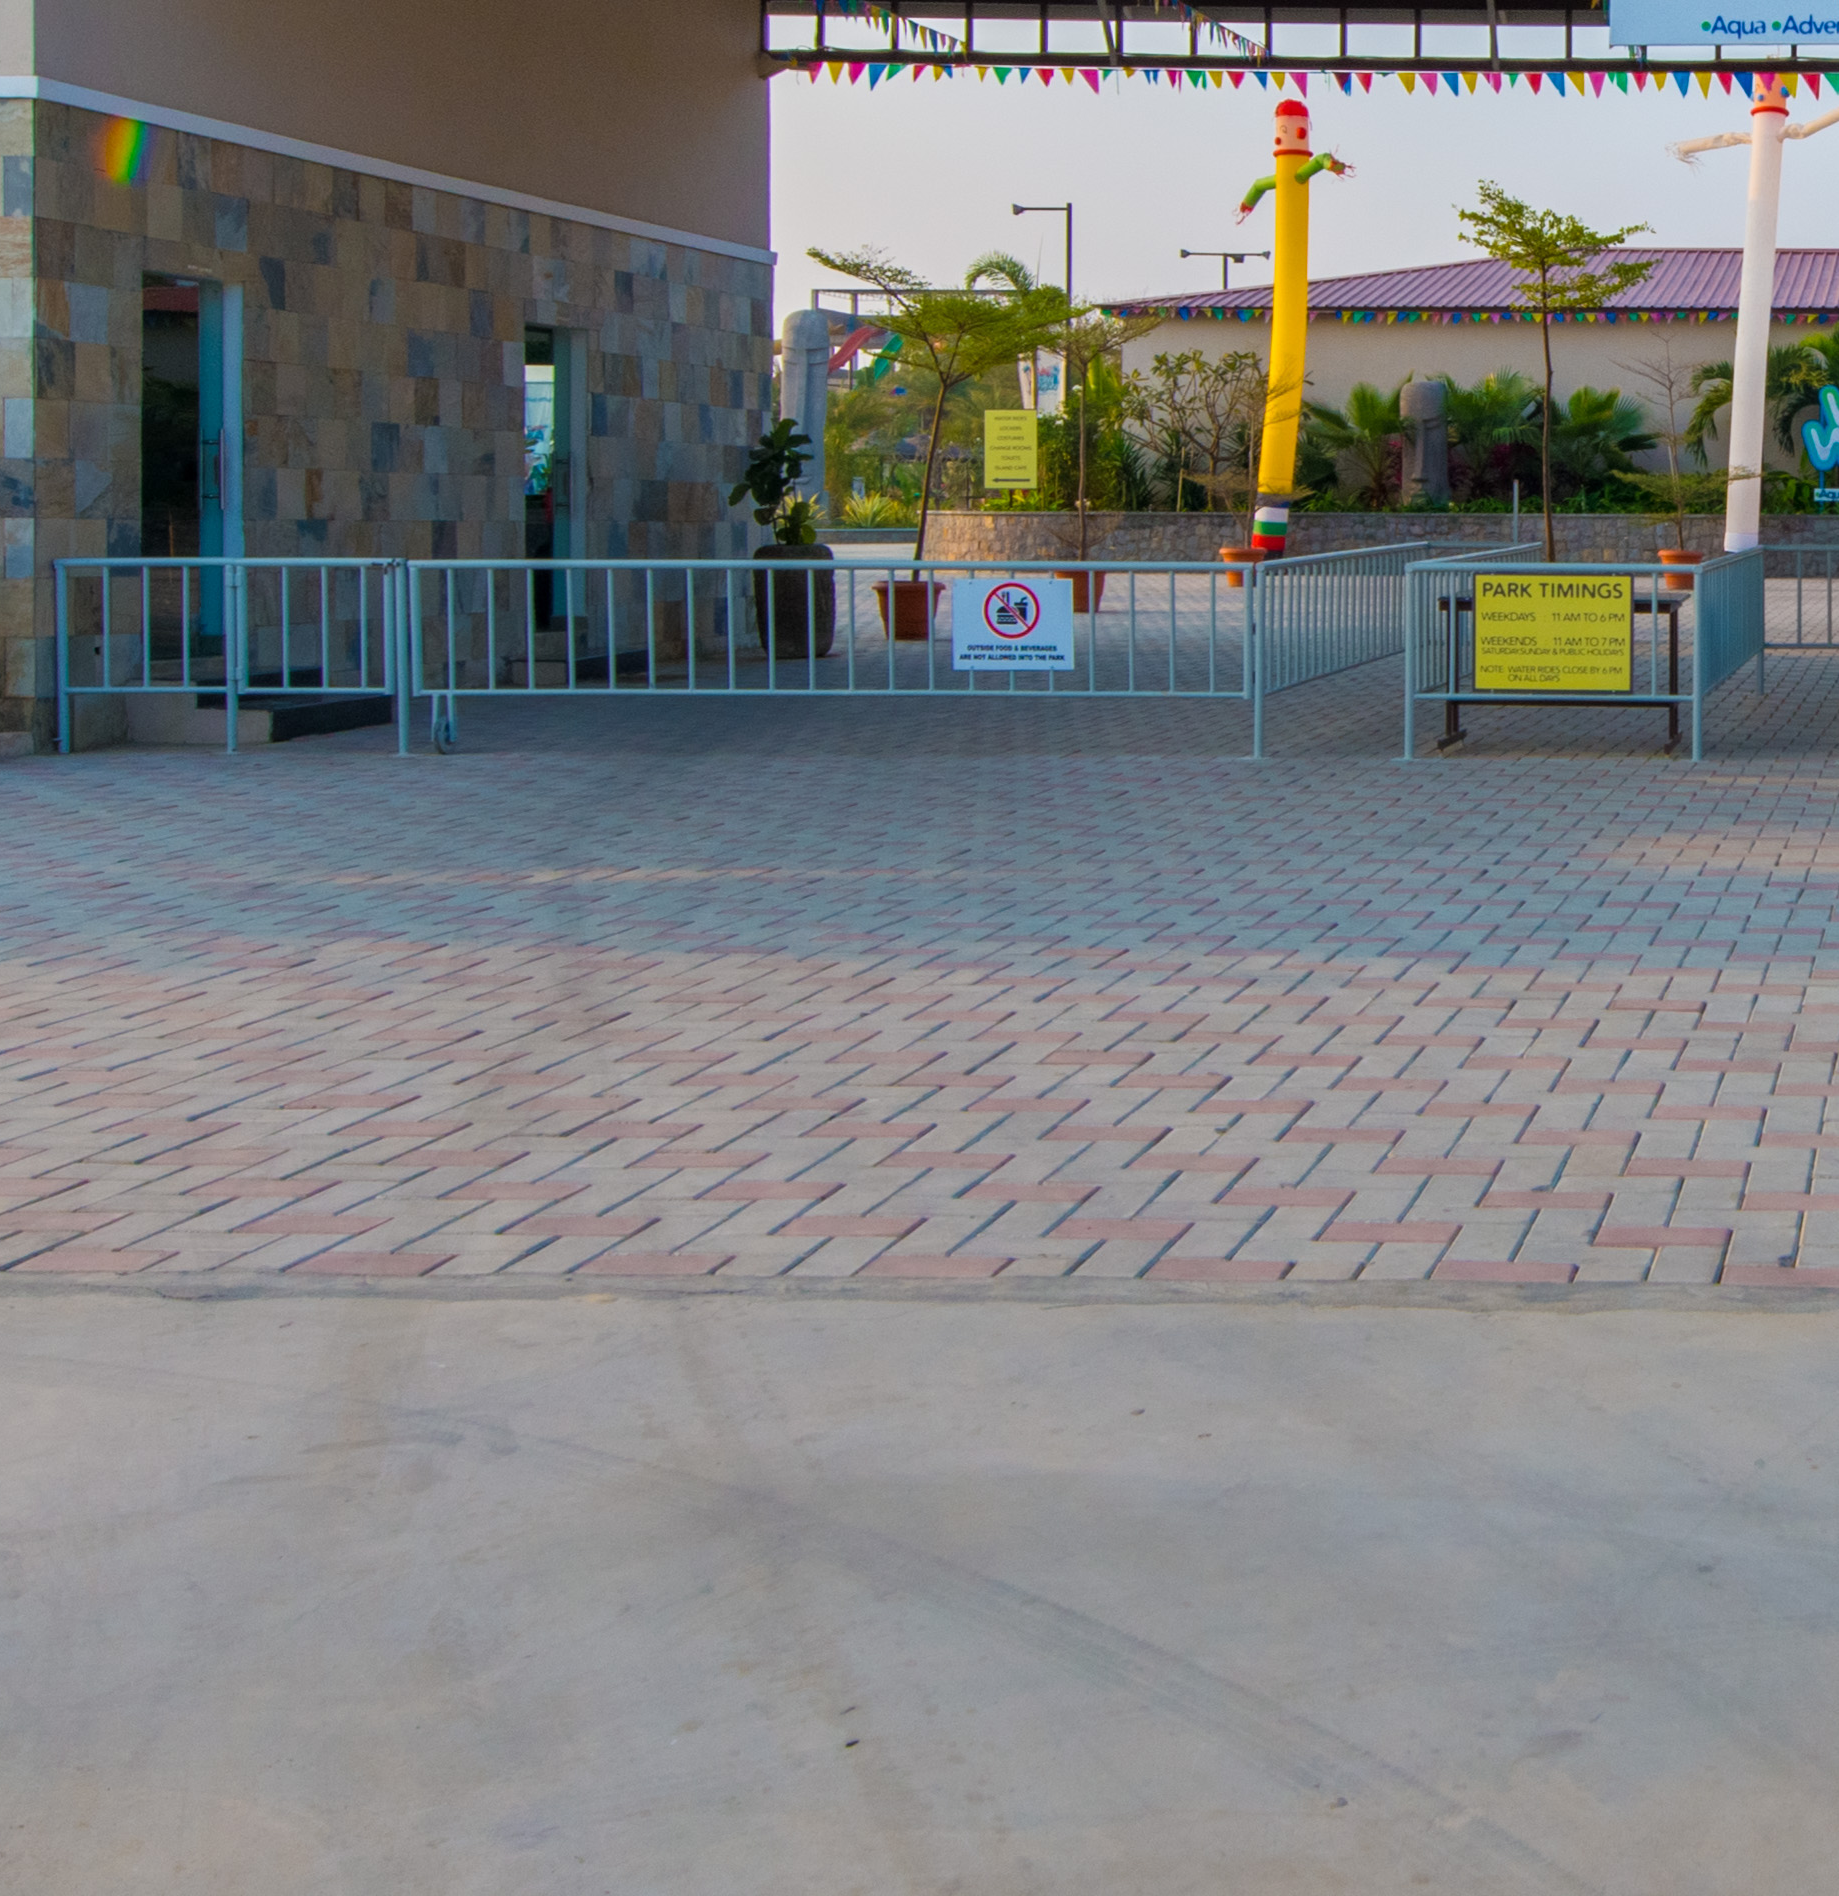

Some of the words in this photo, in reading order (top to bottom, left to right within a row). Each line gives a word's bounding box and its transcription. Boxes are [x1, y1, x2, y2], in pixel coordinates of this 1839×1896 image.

[1482, 582, 1532, 599] PARK
[1539, 582, 1623, 599] TIMINGS
[1481, 611, 1536, 622] WEEKDAYS
[1552, 612, 1561, 622] 11
[1563, 612, 1581, 622] AM
[1584, 612, 1598, 622] TO
[1600, 612, 1607, 622] 6
[1608, 612, 1625, 622] PM
[1481, 636, 1537, 647] WEEKENDS
[1553, 637, 1562, 647] 11
[1564, 637, 1582, 647] AM
[1585, 637, 1599, 647] TO
[1601, 637, 1607, 647] 7
[1609, 637, 1625, 647] PM
[1559, 648, 1585, 656] PUBLIC
[1587, 648, 1624, 656] HOLIDAYS
[1508, 665, 1536, 673] WATER
[1537, 665, 1561, 674] RIDES
[1562, 666, 1588, 674] CLOSE
[1590, 666, 1600, 674] BY
[1508, 674, 1522, 683] ON
[1523, 674, 1538, 683] ALL
[1539, 674, 1561, 683] DAYS
